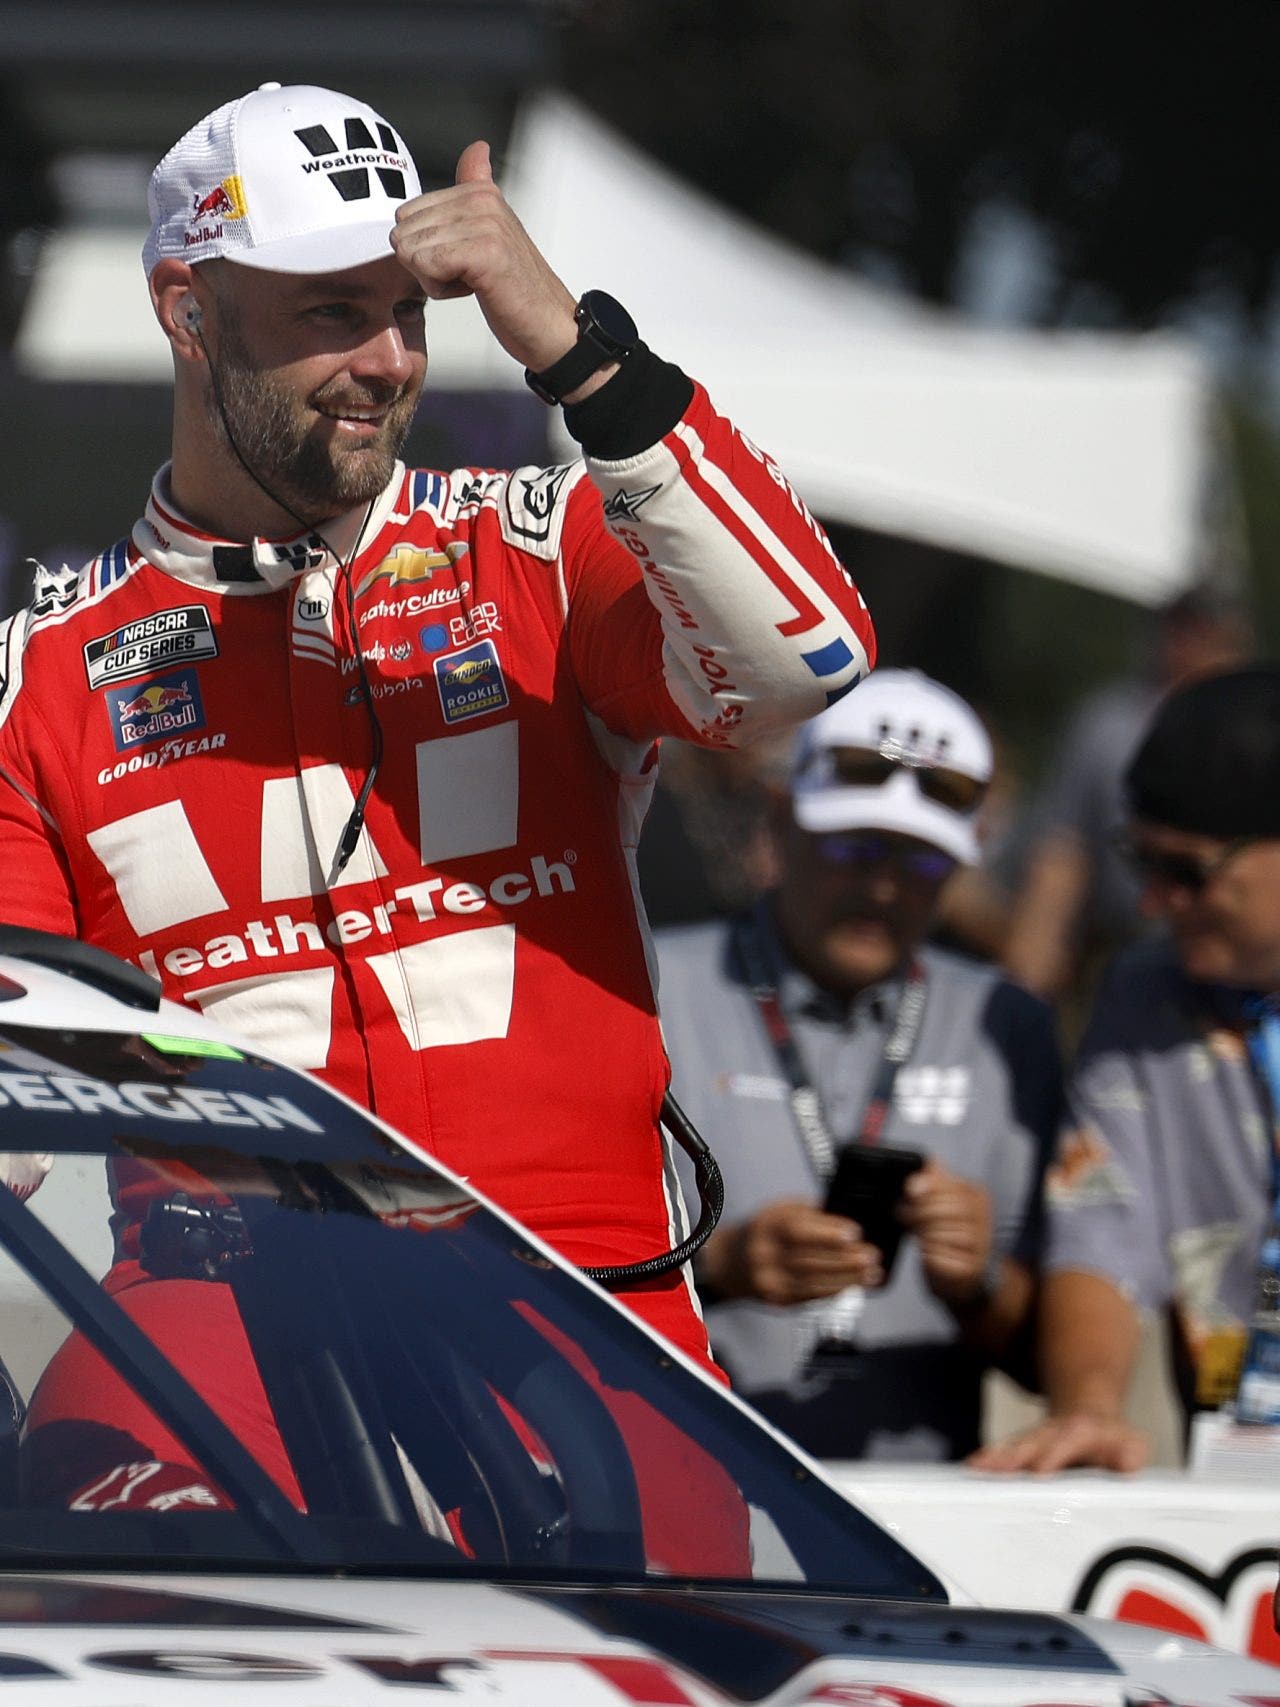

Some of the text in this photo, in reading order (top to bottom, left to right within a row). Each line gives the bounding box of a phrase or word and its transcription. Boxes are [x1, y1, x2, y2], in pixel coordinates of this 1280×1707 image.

[122, 611, 189, 645] NASCAR
[104, 634, 196, 672] CUP SERIES
[447, 684, 501, 709] ROOKIE
[121, 703, 197, 744] Red Bull
